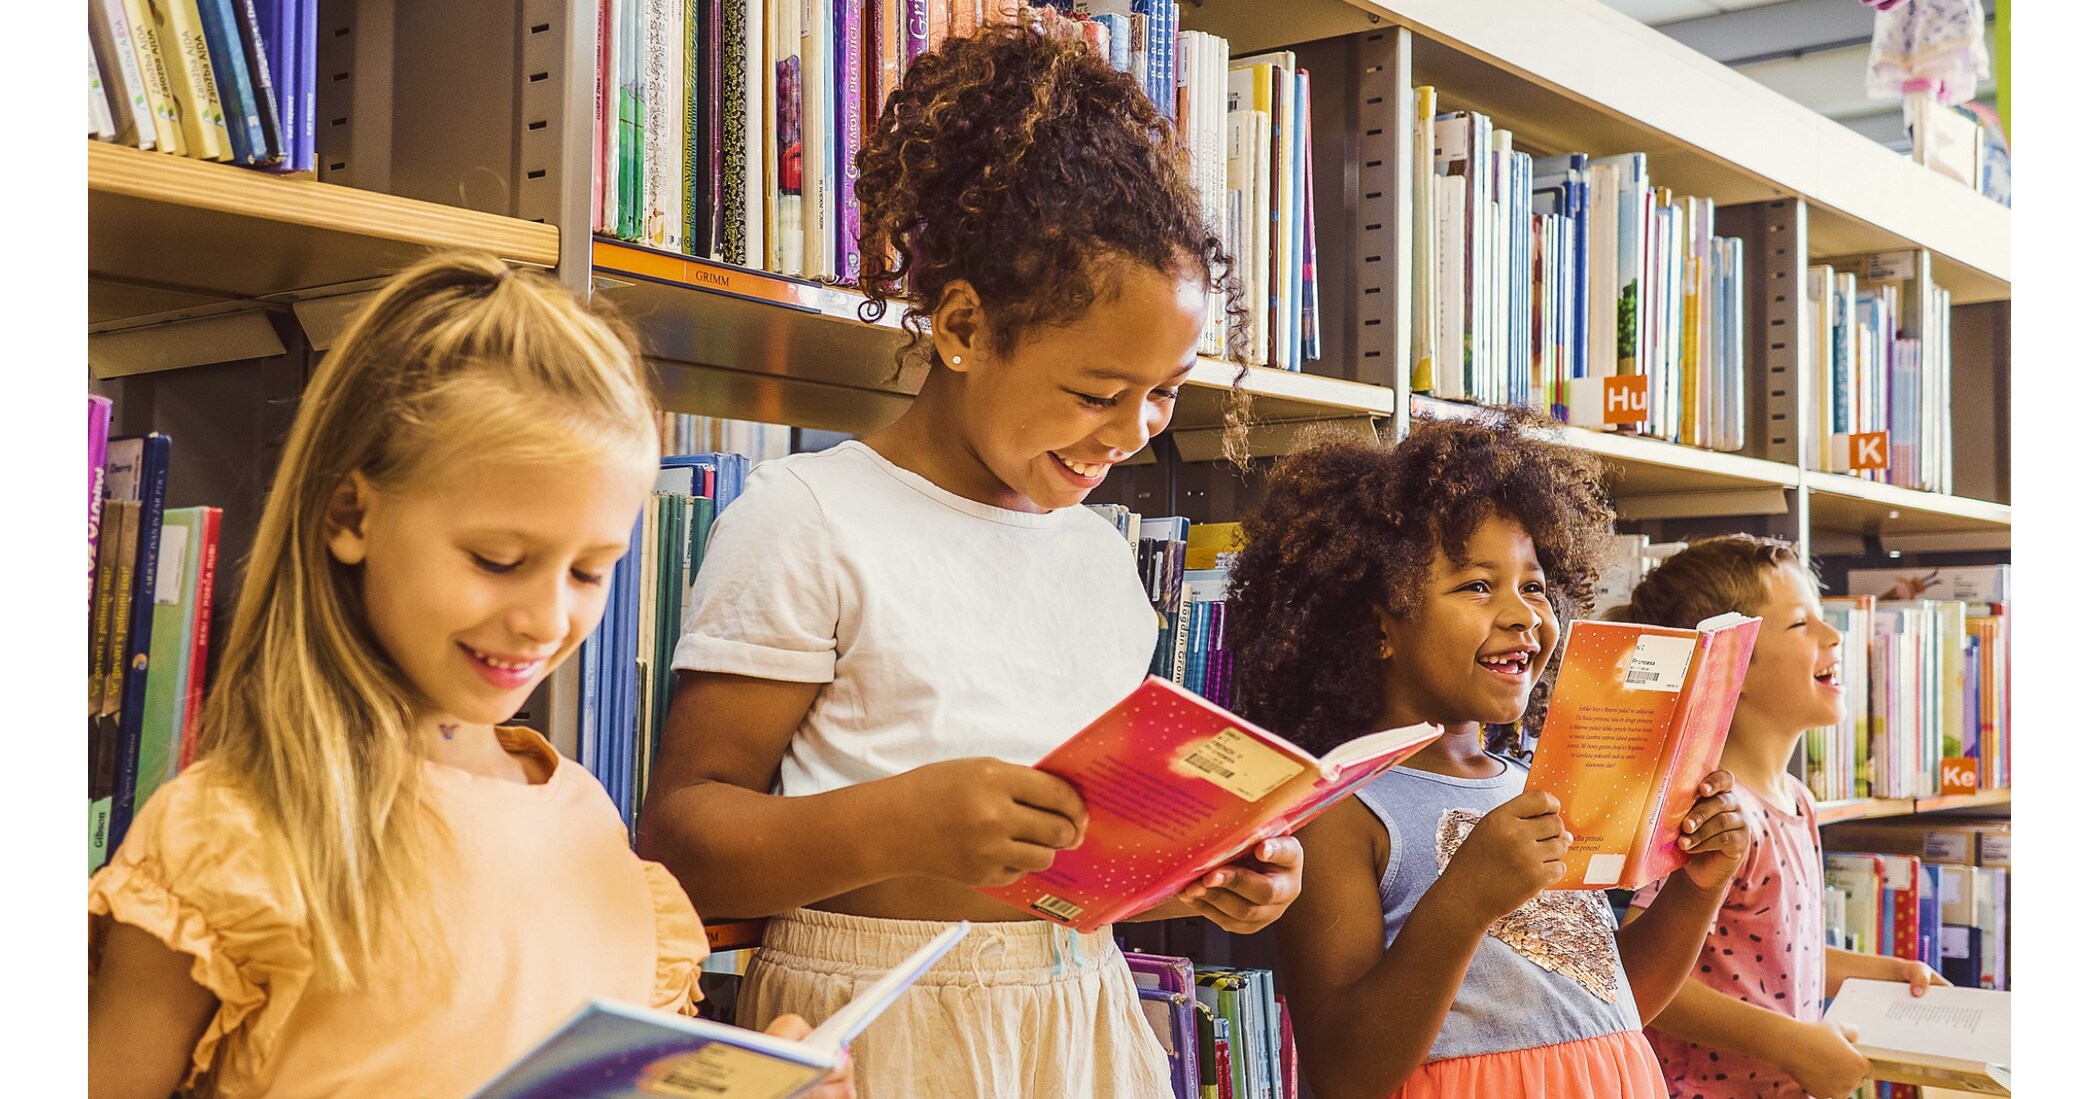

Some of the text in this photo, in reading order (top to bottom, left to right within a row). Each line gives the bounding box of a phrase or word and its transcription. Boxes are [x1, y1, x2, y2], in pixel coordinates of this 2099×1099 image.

[849, 23, 858, 93] PRAVLJICE
[203, 64, 218, 104] Založba
[685, 95, 693, 134] Grimm
[684, 139, 692, 184] Wilhelm
[695, 270, 730, 287] GRIMM
[1608, 386, 1648, 411] Hu
[1858, 436, 1883, 464] K
[1174, 601, 1192, 684] Bogdan Grom
[1943, 767, 1976, 787] Ke
[95, 812, 107, 848] Gibson
